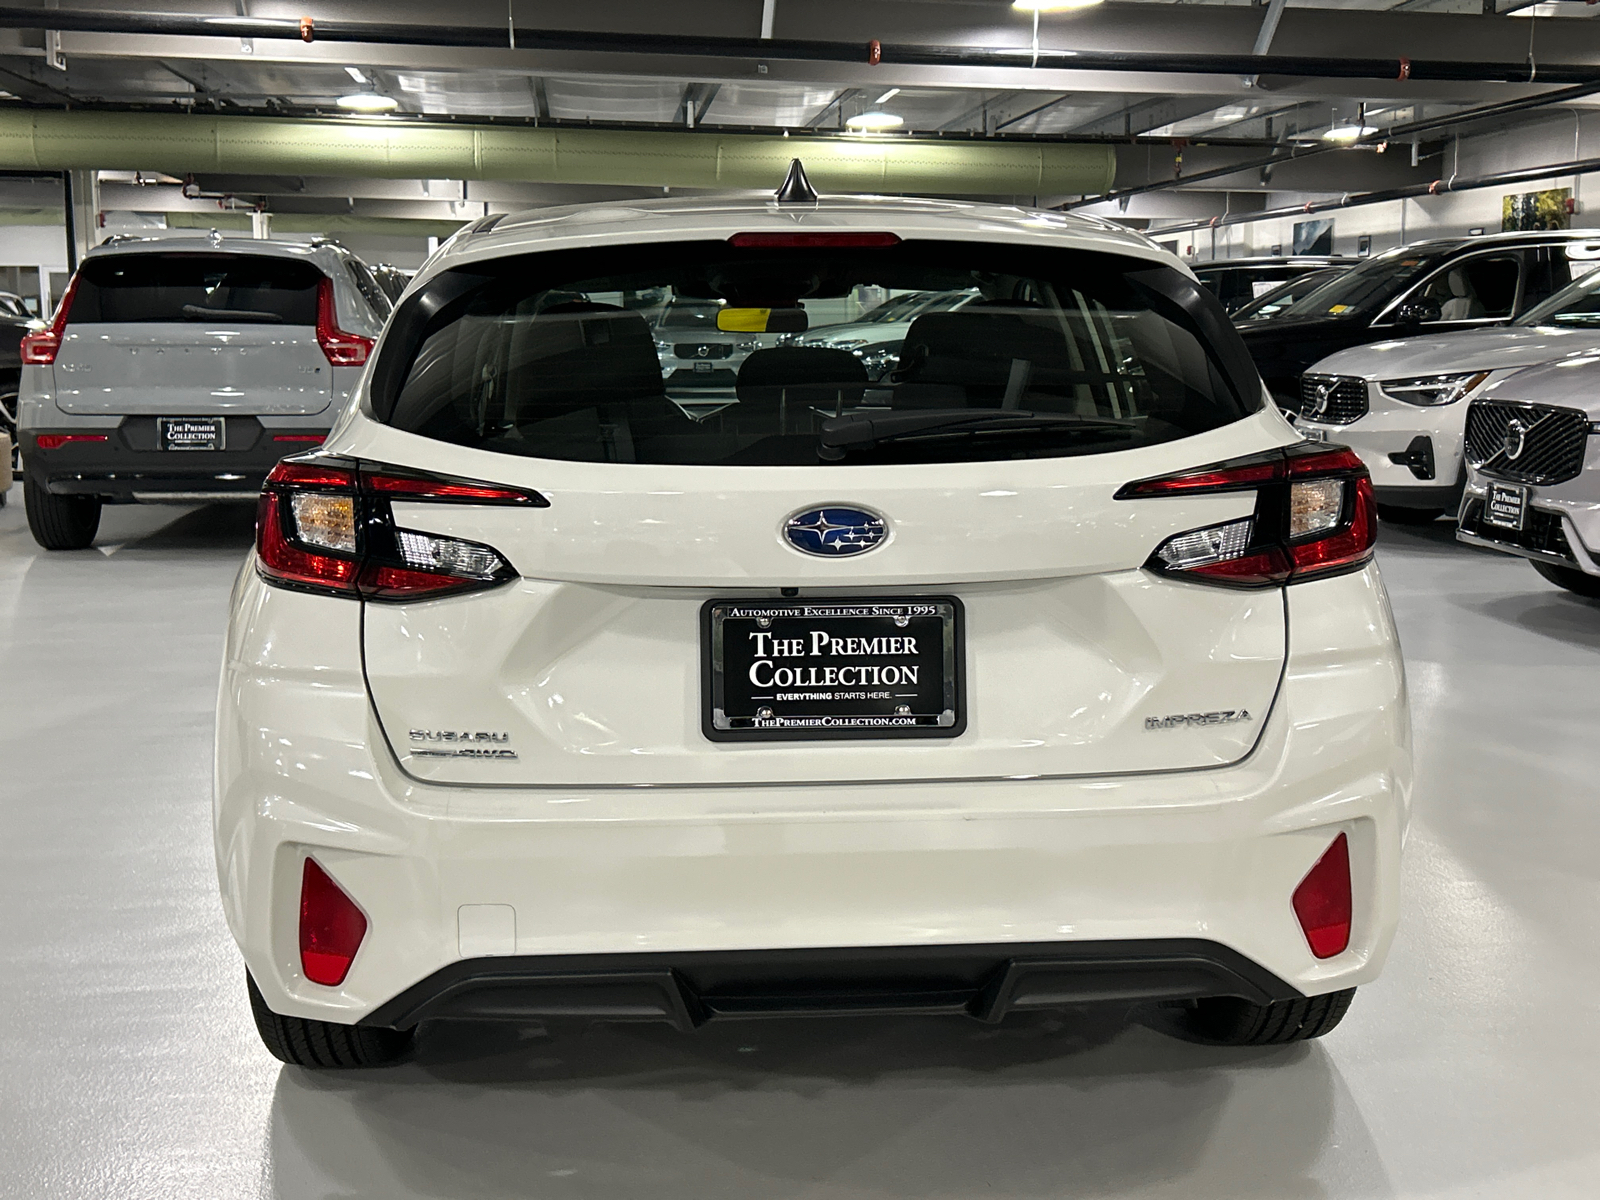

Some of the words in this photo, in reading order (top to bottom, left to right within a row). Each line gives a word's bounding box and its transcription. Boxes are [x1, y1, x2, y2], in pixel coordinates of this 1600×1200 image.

[167, 431, 216, 440] COLLECTION
[907, 605, 936, 615] 1995
[748, 659, 920, 687] COLLECTION
[776, 692, 833, 701] EVERYTHING
[834, 692, 865, 700] STARTS
[867, 691, 893, 700] HERE.
[1144, 708, 1254, 730] IMPREZA
[408, 729, 509, 743] SUBARU
